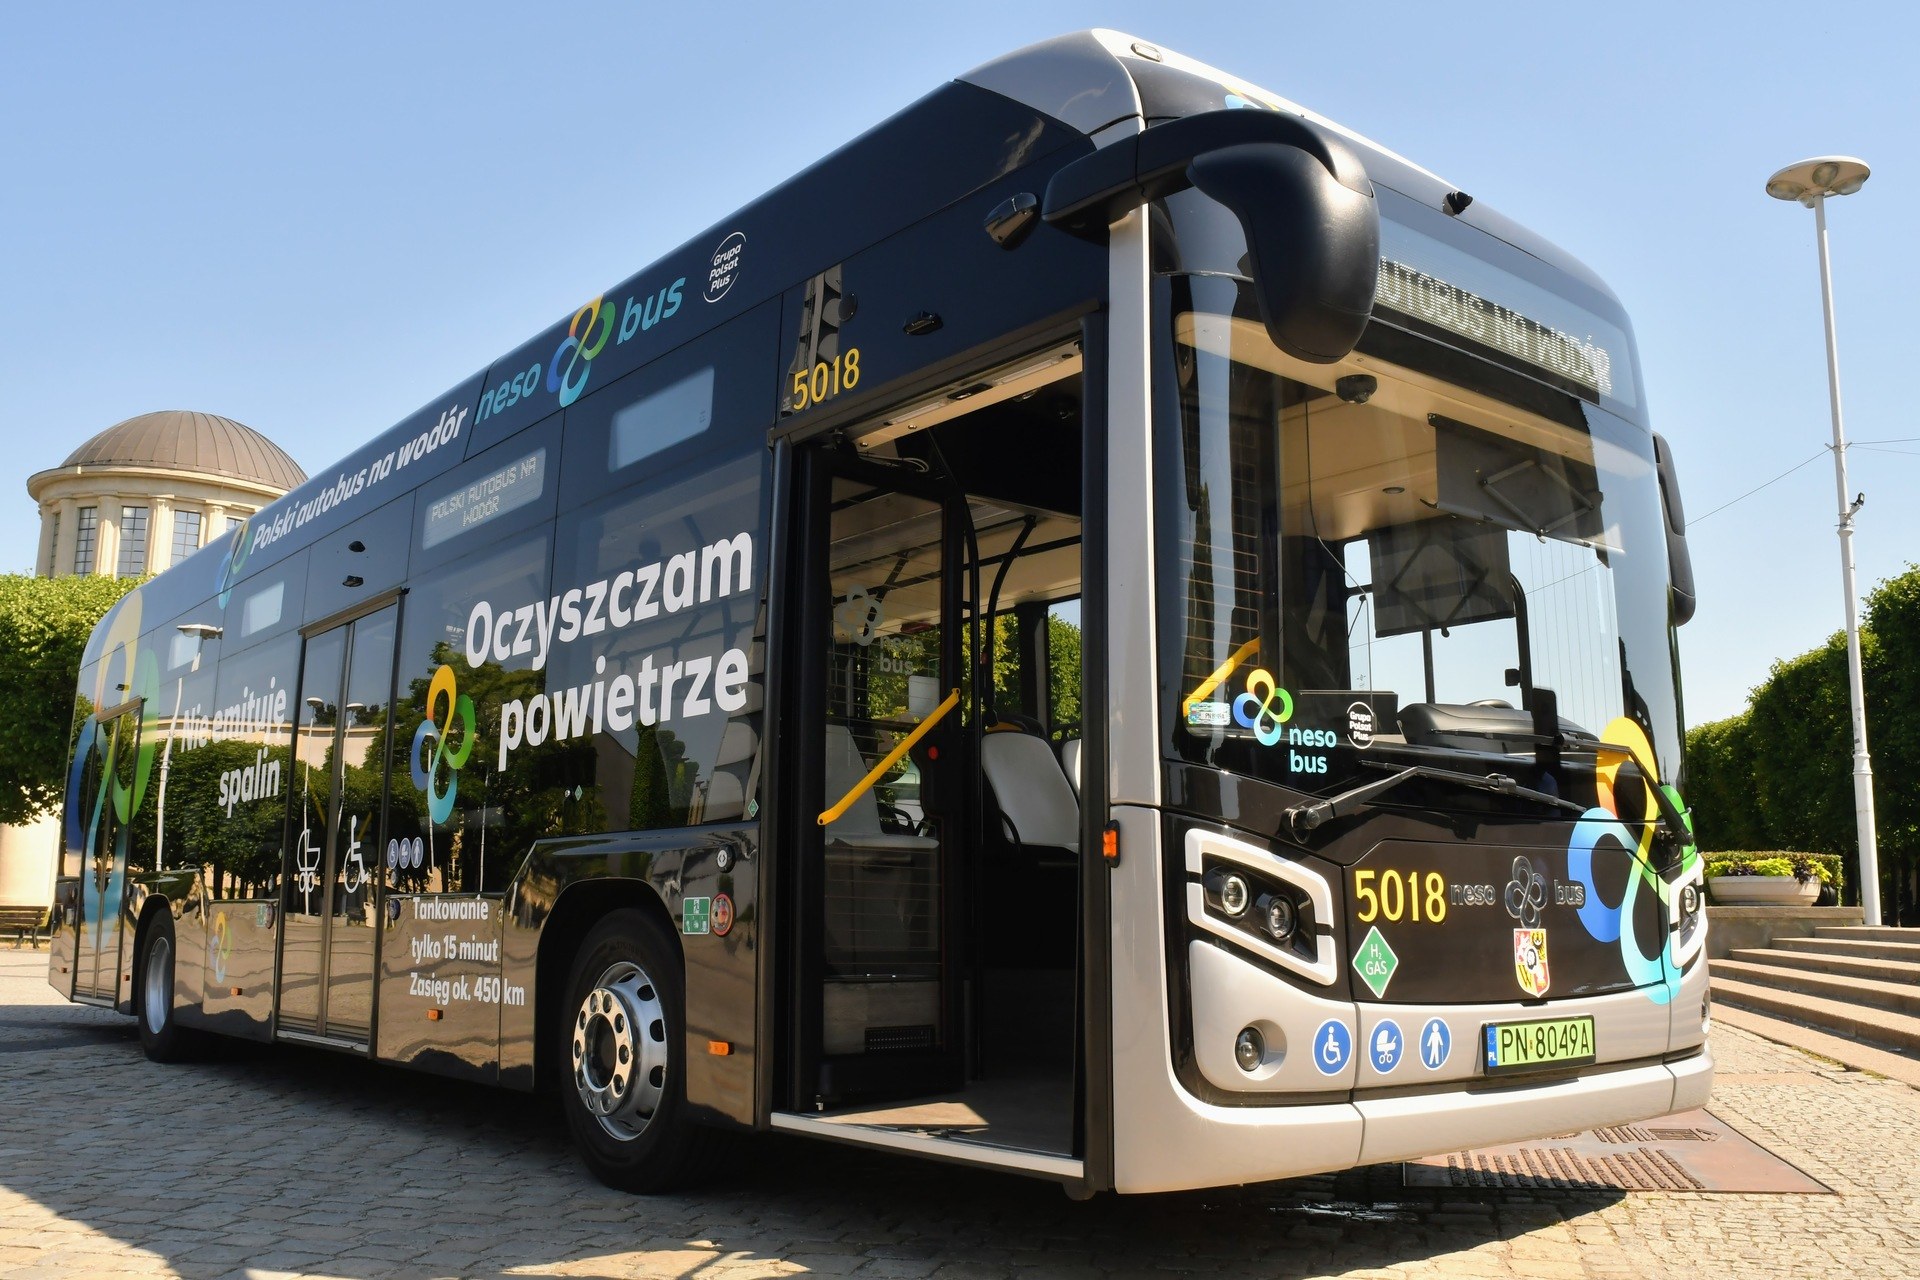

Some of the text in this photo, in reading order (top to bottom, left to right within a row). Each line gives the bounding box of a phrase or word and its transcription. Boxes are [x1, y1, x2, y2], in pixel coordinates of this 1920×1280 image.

[709, 256, 739, 281] Polsat
[713, 244, 742, 266] Grupa
[710, 274, 731, 293] Plus
[1374, 255, 1611, 394] UTOBUS NA WODÓR
[474, 277, 686, 425] neso bus
[793, 348, 860, 410] 5018
[250, 404, 468, 554] Polski autobus na wodór
[431, 457, 536, 521] POLSKI AUTOBUS NA
[463, 495, 499, 527] WODÓR
[465, 531, 753, 671] Oczyszczam
[879, 651, 914, 675] bus
[181, 676, 287, 753] Nie emituję
[498, 648, 749, 772] powietrze
[1349, 720, 1372, 731] Polsat
[1350, 711, 1371, 723] Grupa
[1289, 727, 1337, 748] neso
[1353, 730, 1369, 741] Plus
[1290, 749, 1328, 774] bus
[218, 746, 281, 819] spalin
[412, 894, 489, 920] Tankowanie
[1355, 869, 1447, 923] 5018
[1450, 879, 1585, 906] neso bus
[411, 934, 498, 964] tylko 15 minut
[1365, 960, 1388, 976] GAS
[409, 972, 525, 1006] Zasięg ok. 450 km
[1488, 1022, 1590, 1062] PL PN 8049A
